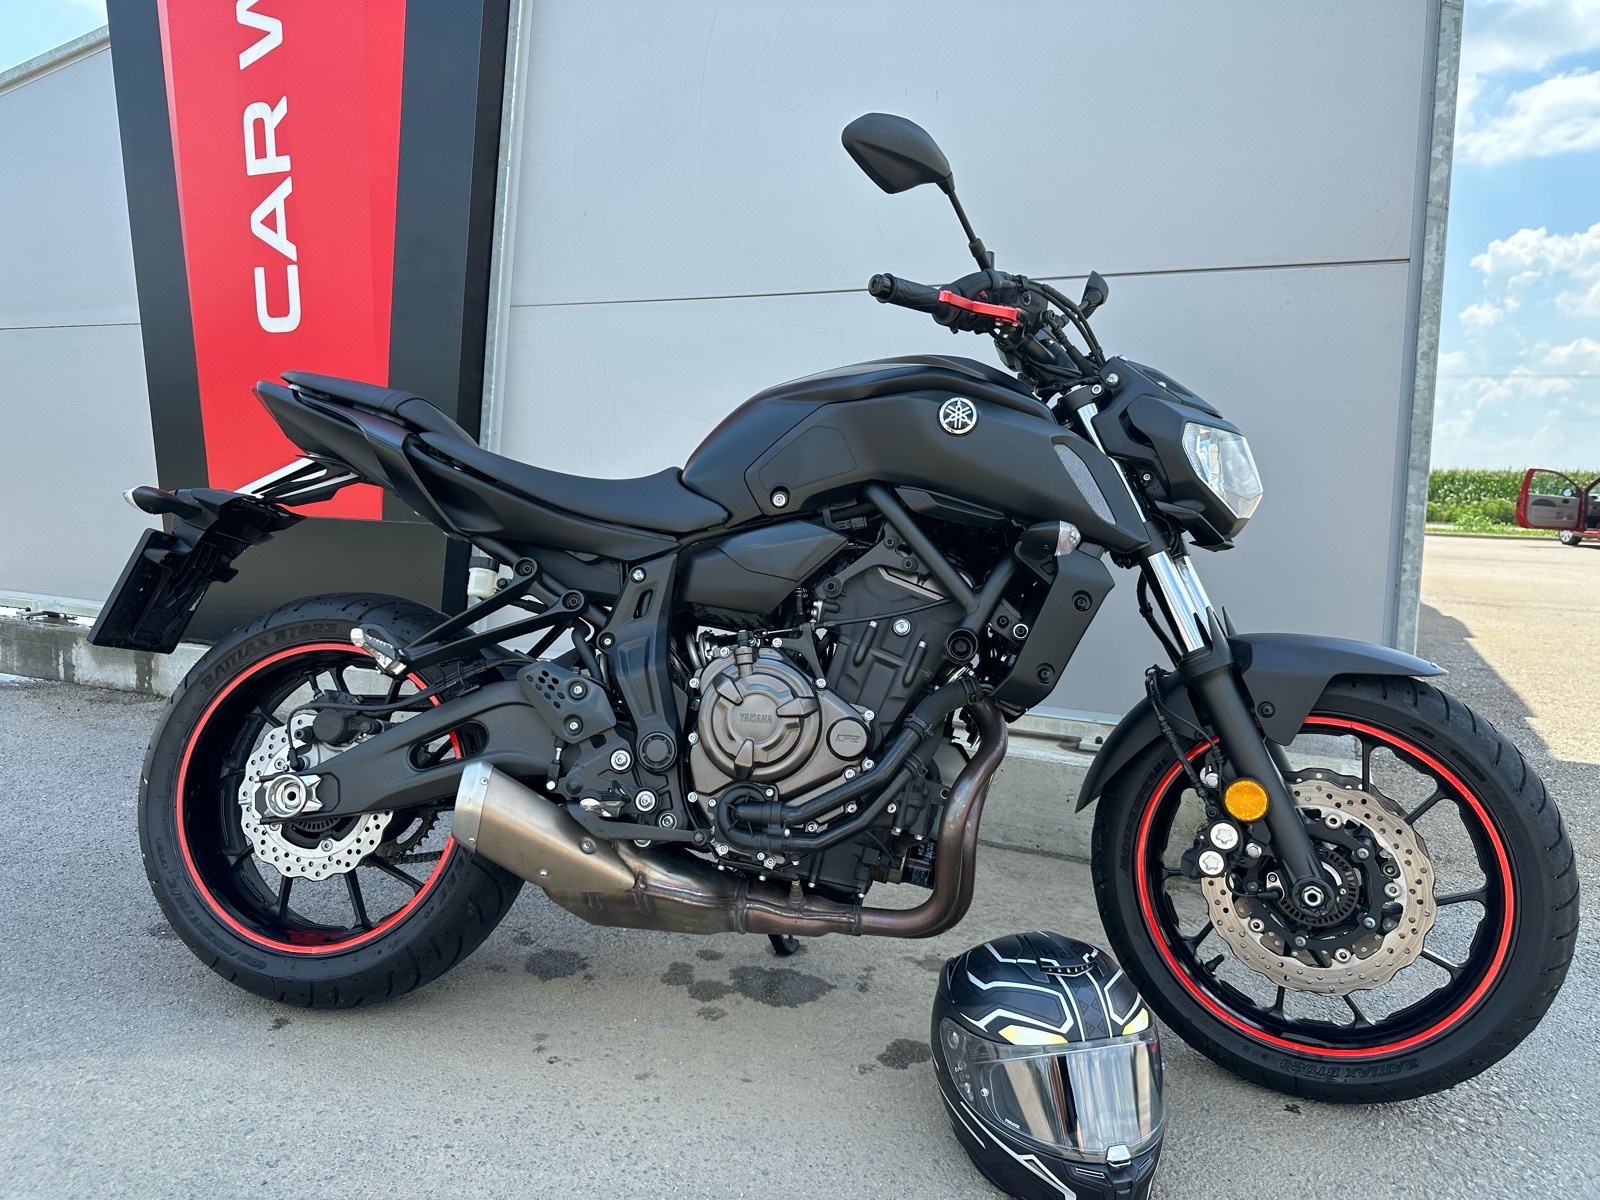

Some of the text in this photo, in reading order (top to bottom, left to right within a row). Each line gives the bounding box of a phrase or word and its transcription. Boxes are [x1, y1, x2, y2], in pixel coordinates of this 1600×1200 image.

[243, 95, 301, 333] CAR
[739, 712, 773, 724] YAMAHA
[1345, 1057, 1419, 1079] BATTLAX
